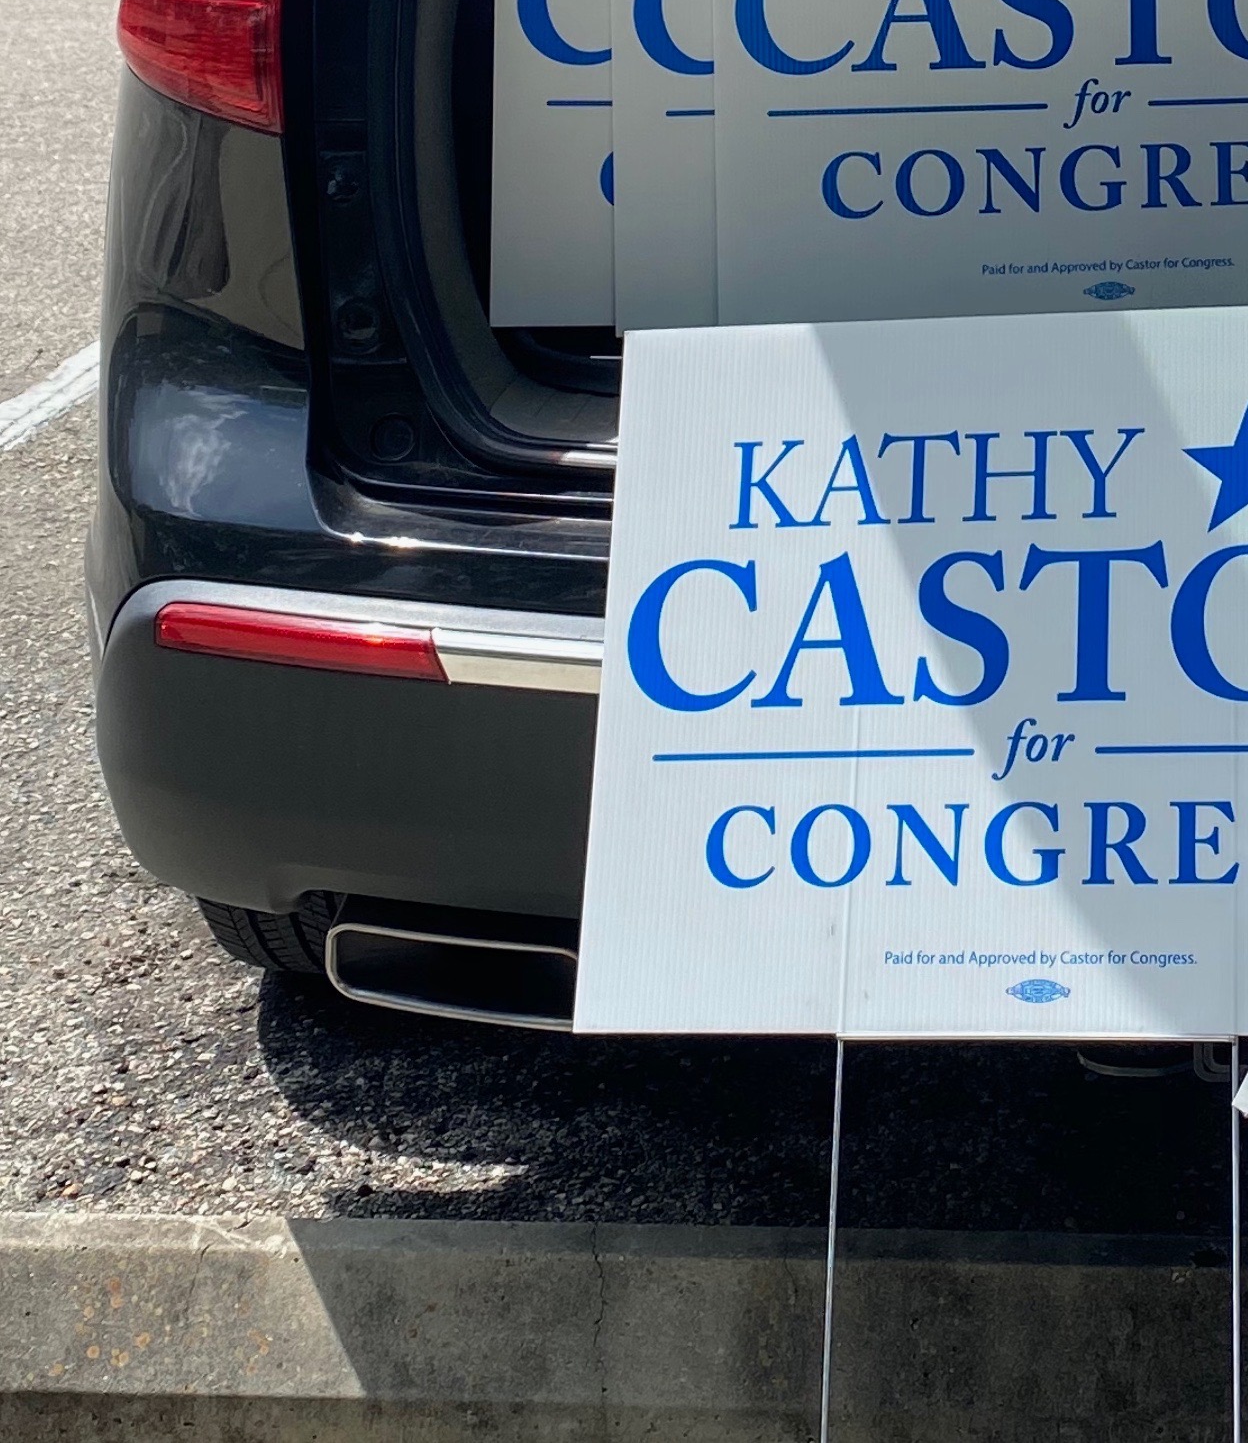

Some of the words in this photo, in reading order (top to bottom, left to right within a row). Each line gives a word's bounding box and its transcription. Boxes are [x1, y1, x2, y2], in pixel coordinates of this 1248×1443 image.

[1063, 78, 1132, 130] for
[981, 263, 1006, 276] Paid
[1008, 262, 1024, 275] for
[1027, 261, 1049, 274] and
[1051, 260, 1107, 275] Approved
[1109, 259, 1124, 273] by
[1125, 258, 1161, 271] Castor
[1163, 257, 1179, 269] for
[1181, 256, 1235, 271] Congress.
[727, 426, 1146, 531] KATHY
[991, 717, 1076, 782] for
[884, 950, 913, 965] Paid
[916, 950, 936, 965] for
[938, 950, 966, 965] and
[968, 950, 1037, 968] Approved
[1039, 950, 1056, 968] by
[1060, 950, 1104, 965] Castor
[1107, 949, 1127, 965] for
[1130, 950, 1198, 968] Congress.
